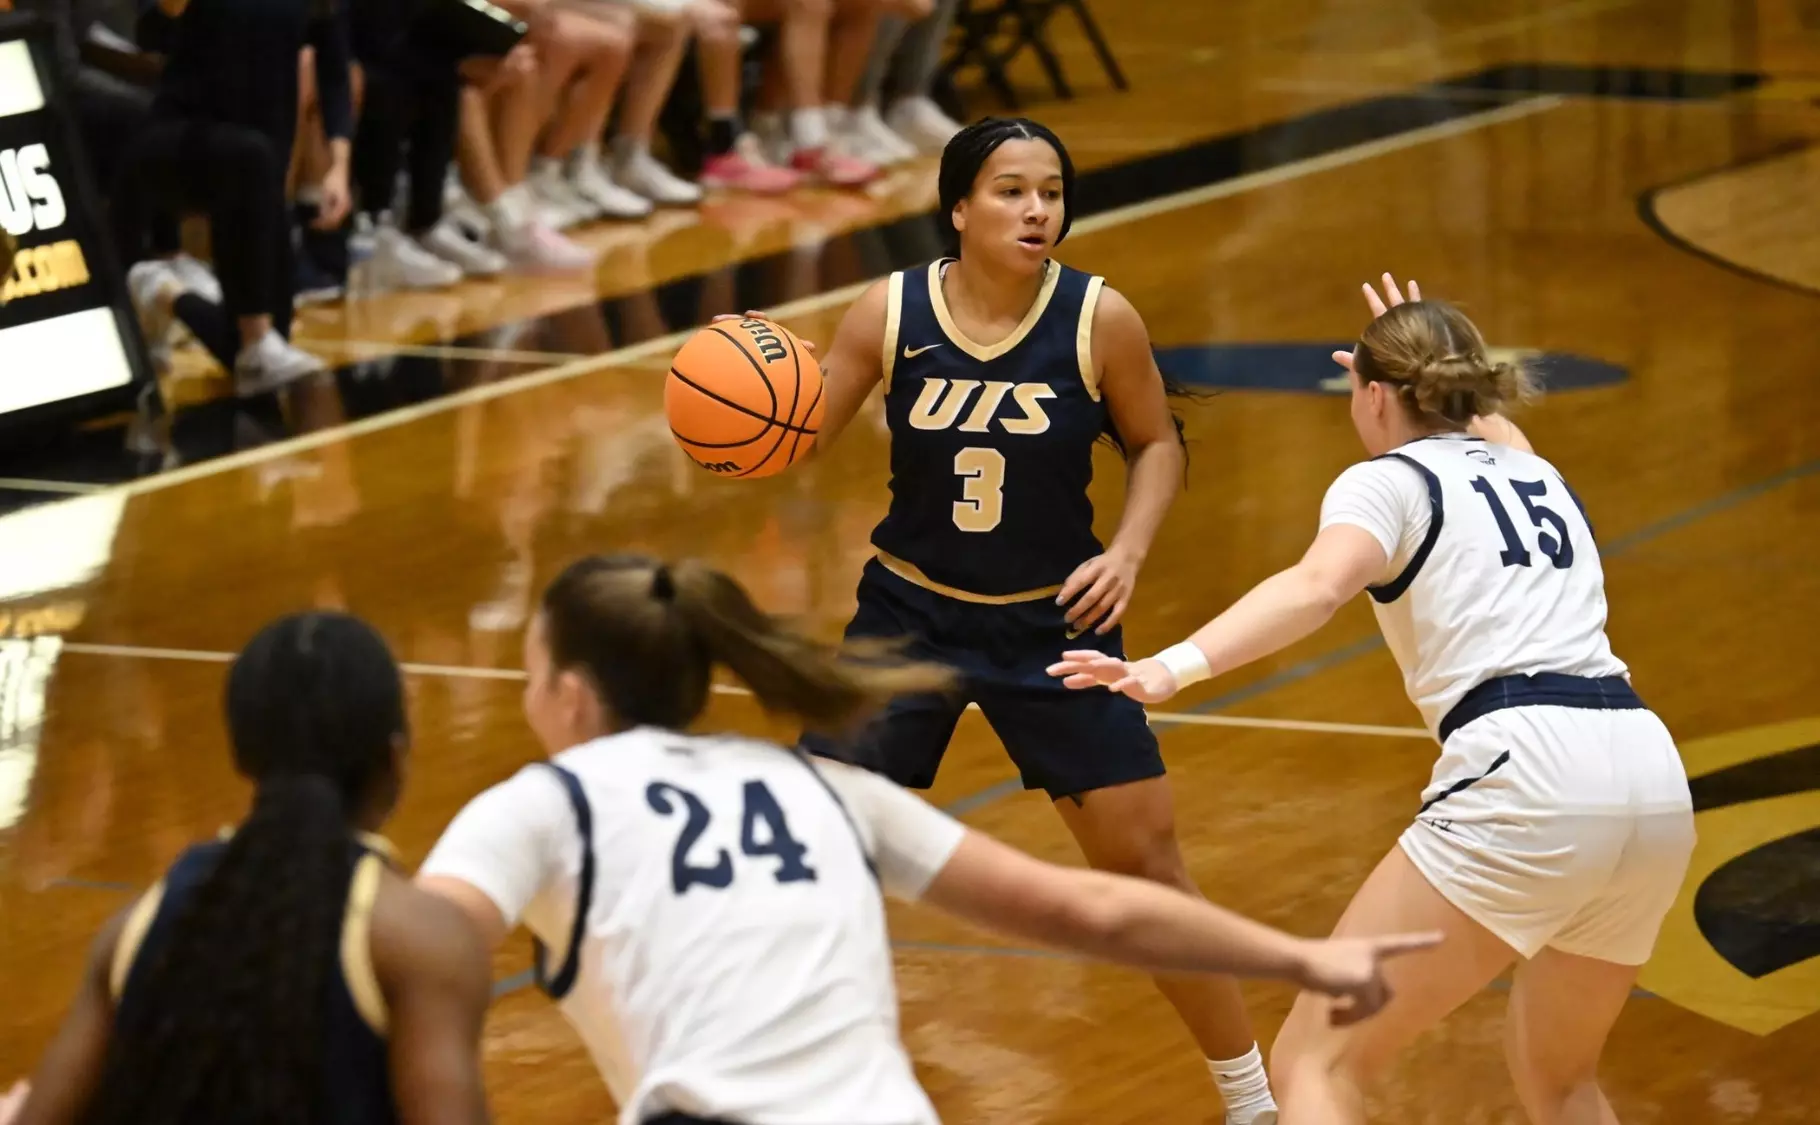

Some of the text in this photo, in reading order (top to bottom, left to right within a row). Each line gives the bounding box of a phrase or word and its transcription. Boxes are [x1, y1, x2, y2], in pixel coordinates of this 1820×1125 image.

[909, 378, 1058, 434] UIS
[952, 447, 1006, 532] 3
[1469, 475, 1574, 569] 15
[646, 781, 817, 895] 24
